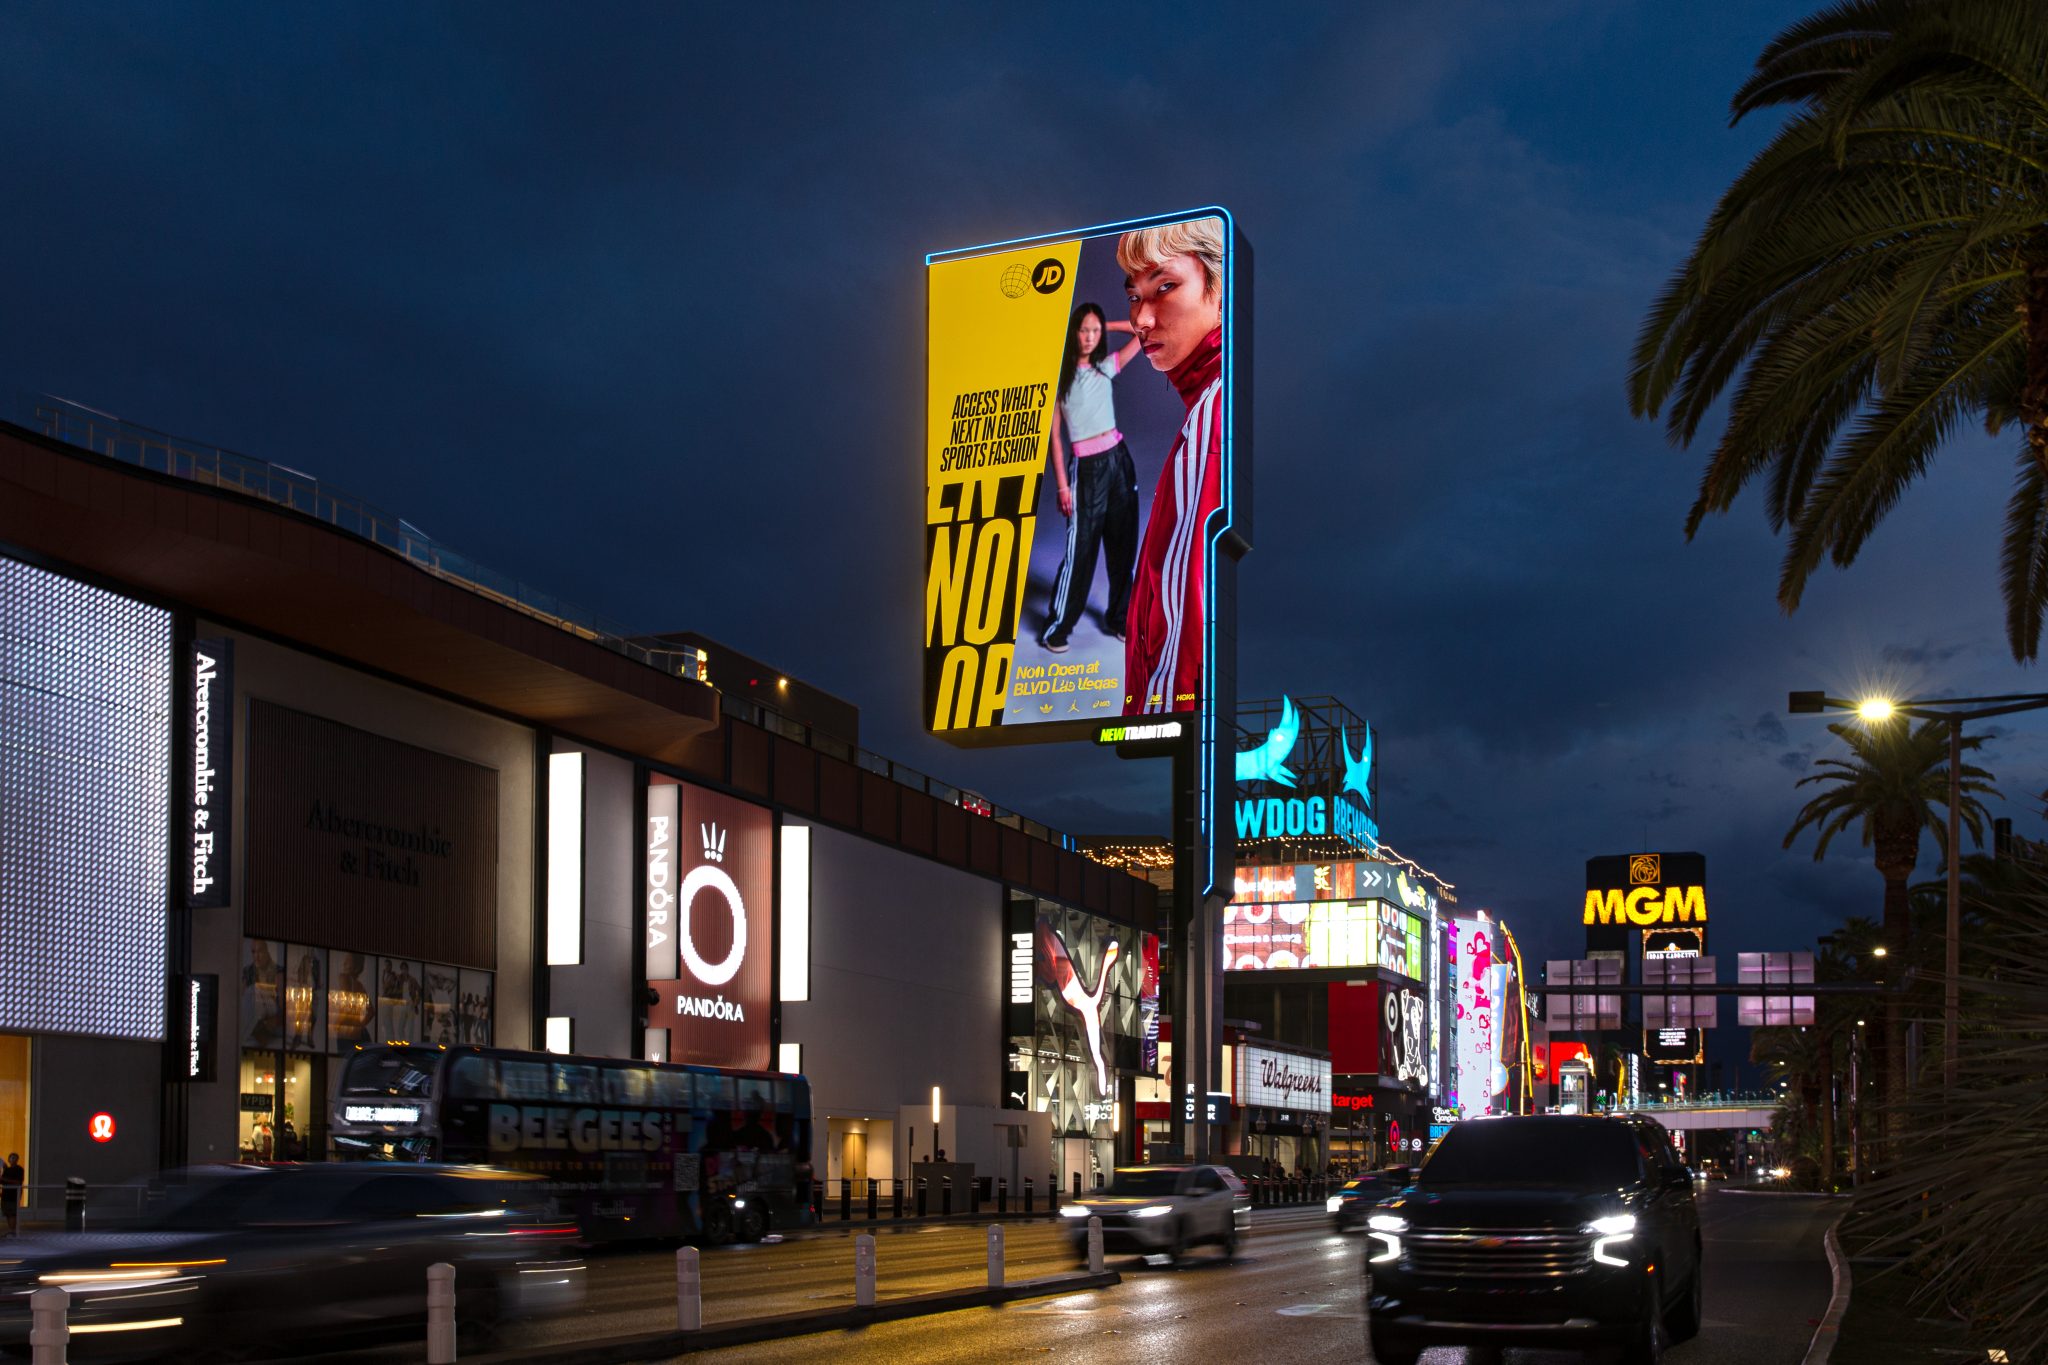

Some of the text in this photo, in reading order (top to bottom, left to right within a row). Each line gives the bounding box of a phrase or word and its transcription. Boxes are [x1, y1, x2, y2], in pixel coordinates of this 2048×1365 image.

[1035, 265, 1062, 288] JD
[951, 382, 1048, 420] ACCESS WHAT'S
[950, 409, 1042, 446] NEXT IN GLOBAL
[940, 436, 1040, 473] SPORTS FASHION
[1085, 660, 1100, 674] at
[1013, 680, 1051, 697] BLVD
[1078, 677, 1119, 691] Vegas
[1176, 693, 1195, 702] HOKA
[193, 651, 217, 895] Abercrombie & Fitch
[1235, 795, 1326, 839] WDOG
[649, 815, 672, 948] PANDORA
[1582, 886, 1708, 925] MGM
[1011, 932, 1034, 1004] PUMA
[677, 994, 745, 1023] PANDORA
[1261, 1057, 1322, 1100] Walgreens
[1332, 1093, 1375, 1110] target
[1432, 1106, 1450, 1115] Olive
[1434, 1113, 1459, 1123] Garden
